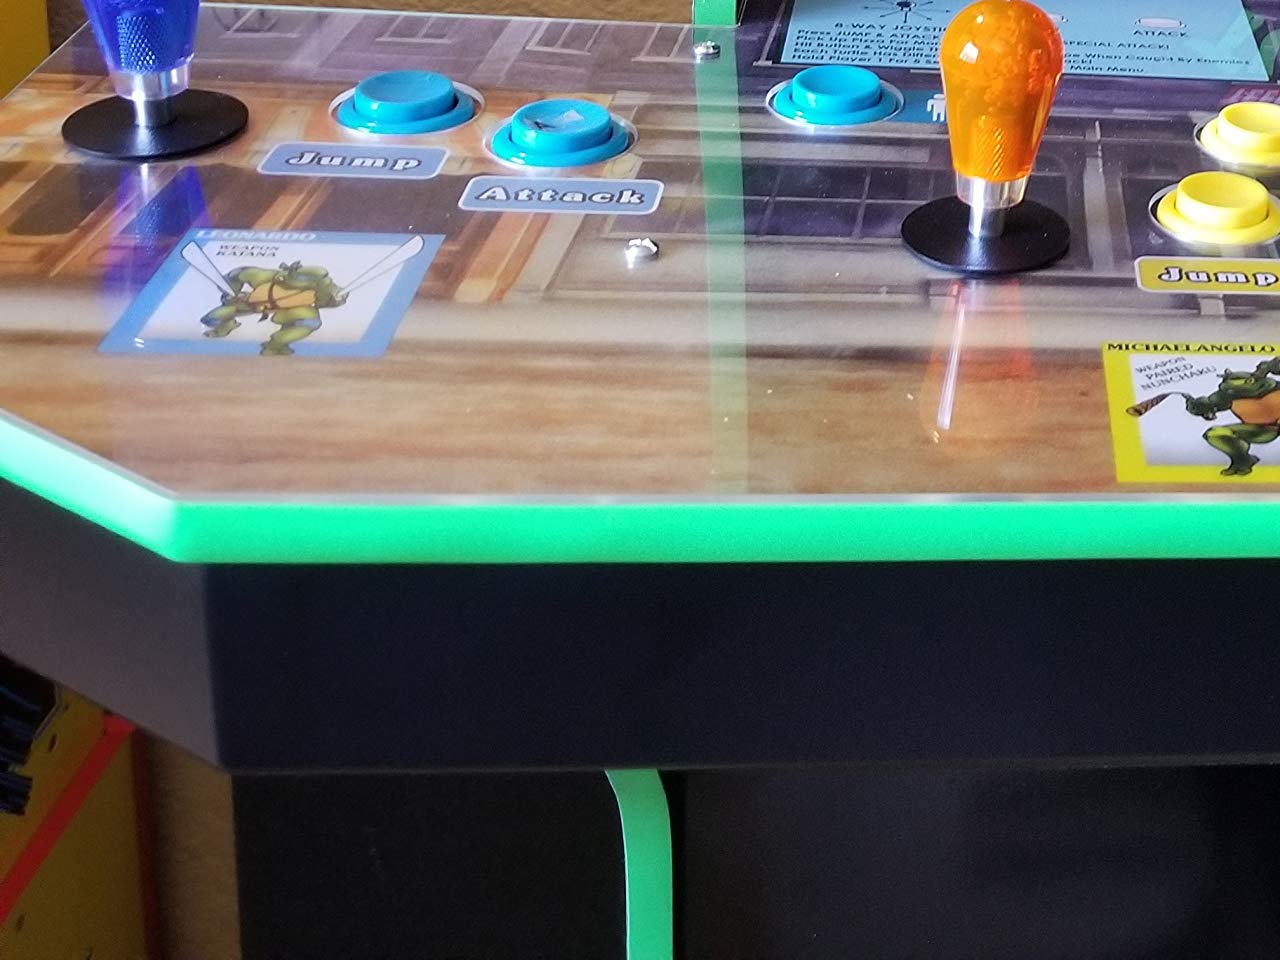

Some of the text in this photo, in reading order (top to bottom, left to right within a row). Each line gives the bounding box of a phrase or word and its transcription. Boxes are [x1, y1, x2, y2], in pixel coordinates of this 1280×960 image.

[1132, 29, 1188, 38] ATTACK
[286, 149, 424, 173] Jump
[475, 184, 647, 206] Attack
[1156, 265, 1280, 288] Jump
[1106, 342, 1276, 353] MICHAELANGELO
